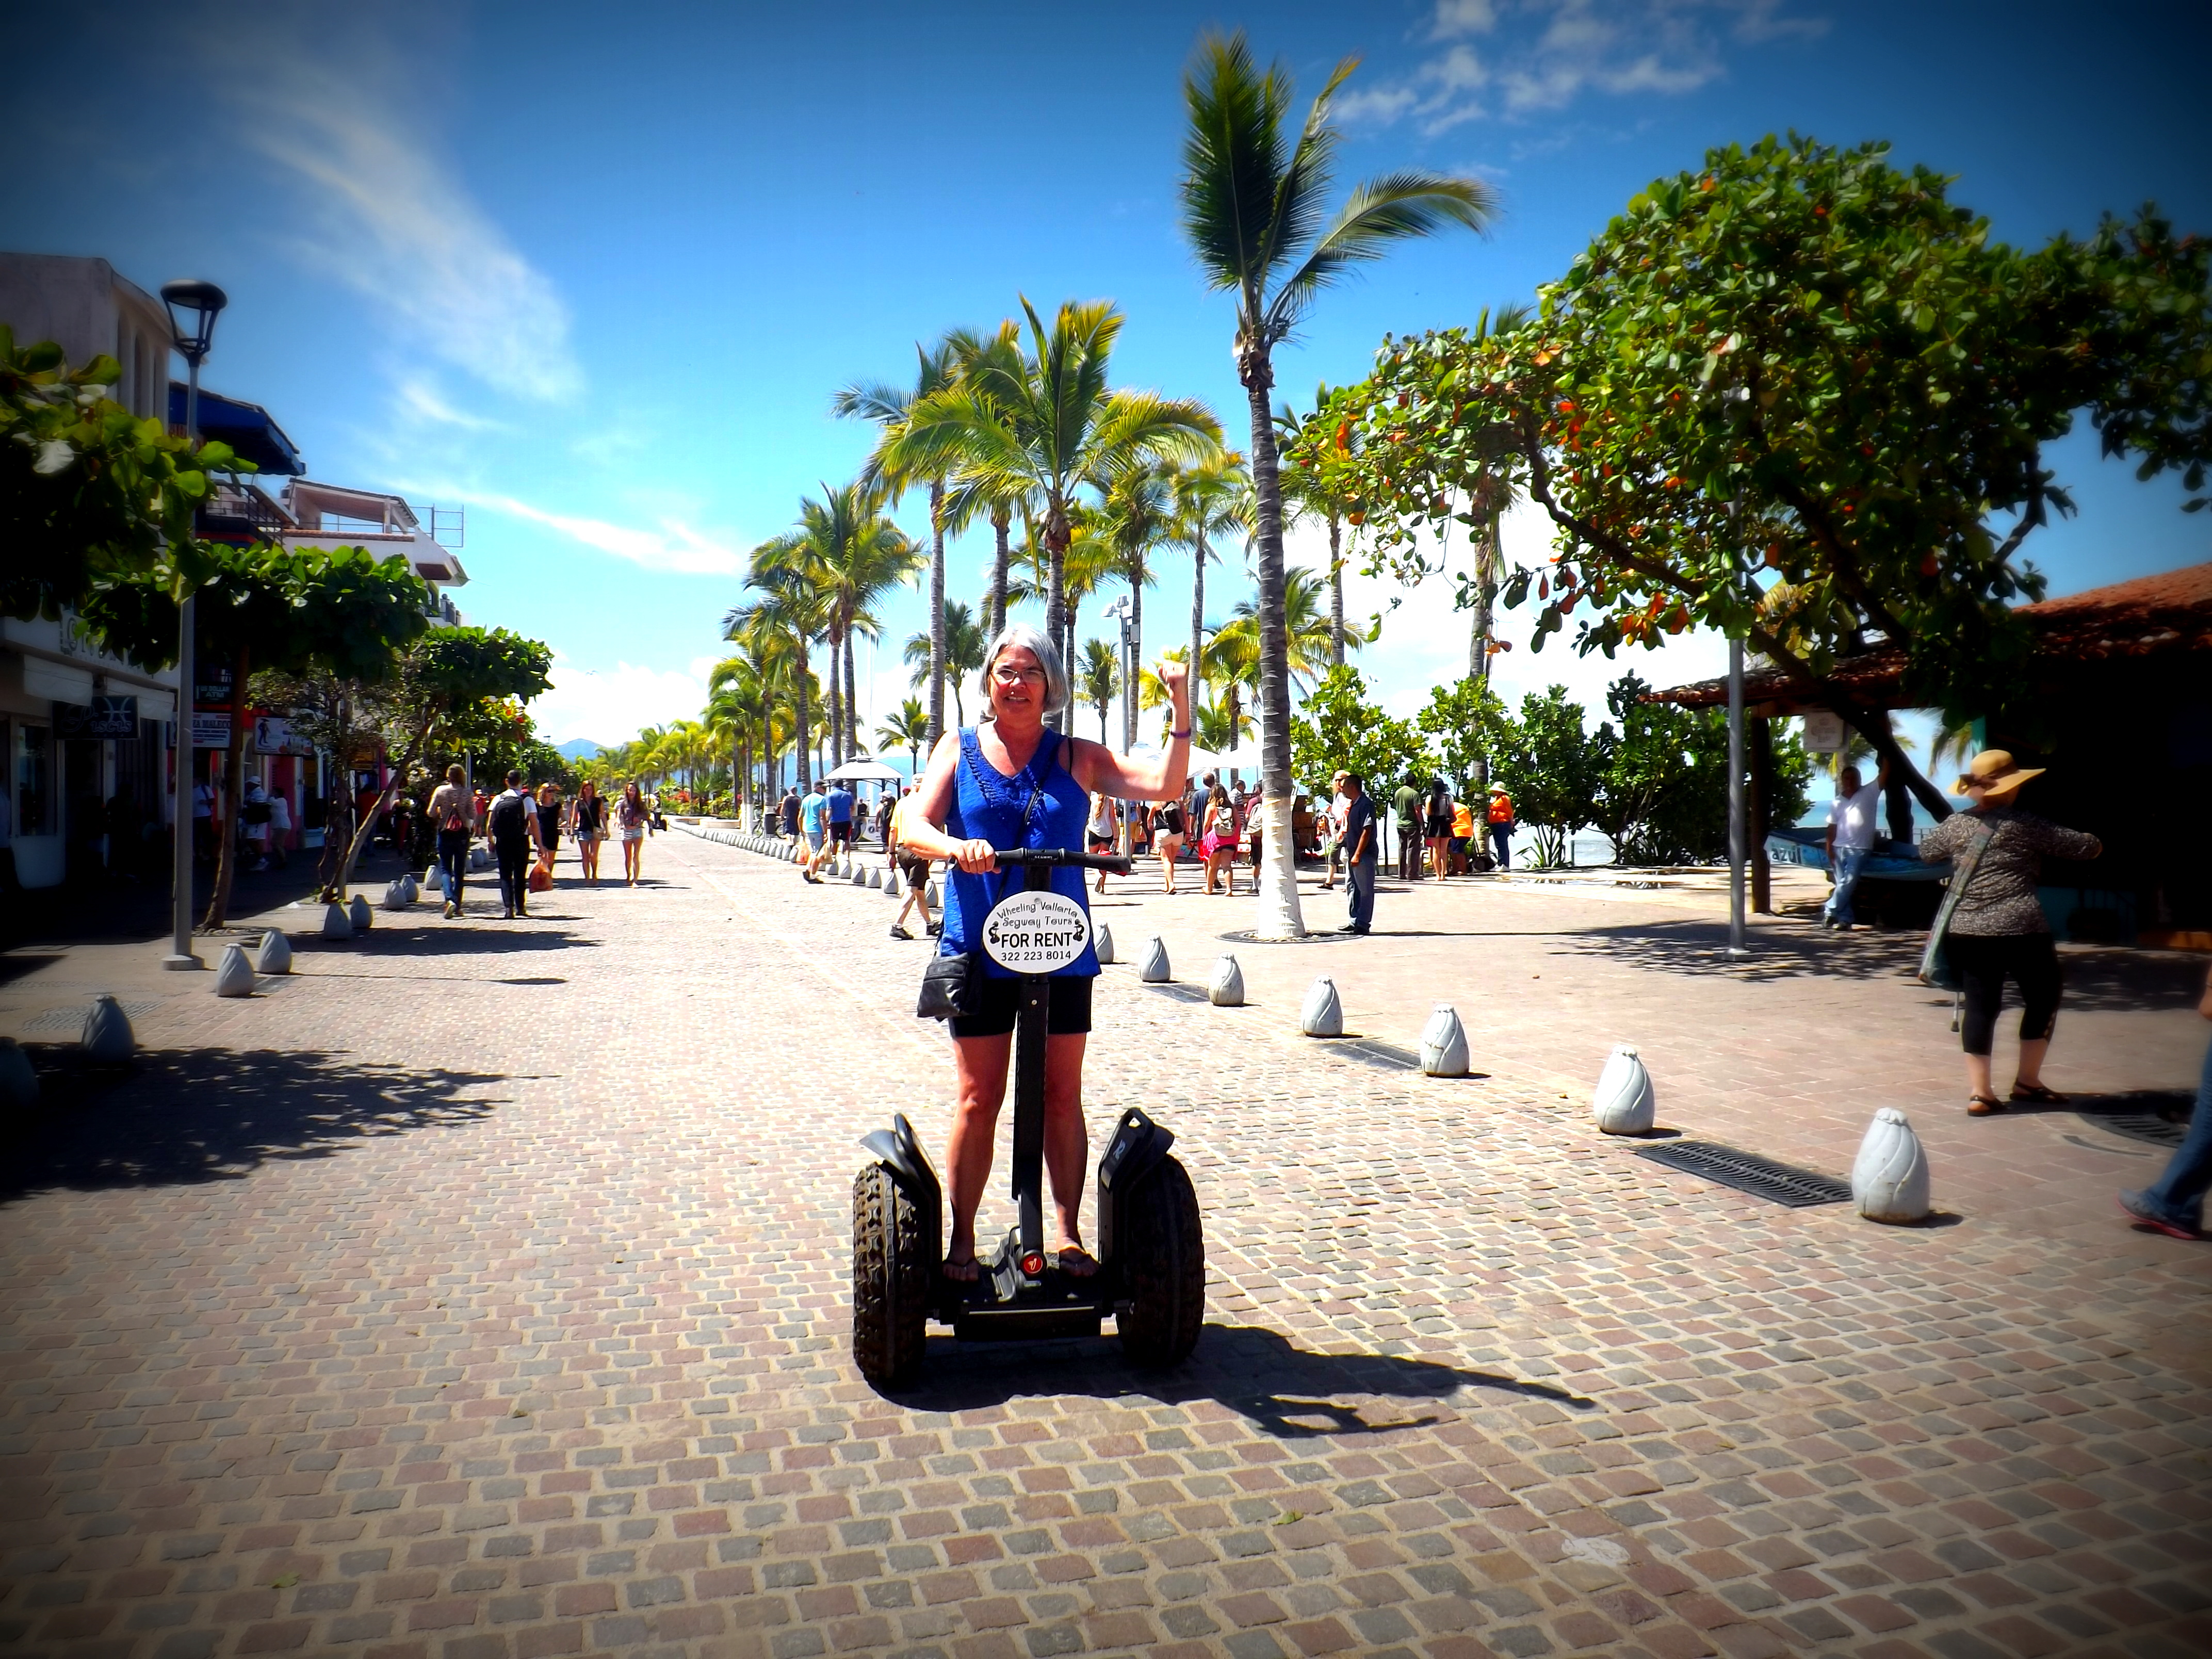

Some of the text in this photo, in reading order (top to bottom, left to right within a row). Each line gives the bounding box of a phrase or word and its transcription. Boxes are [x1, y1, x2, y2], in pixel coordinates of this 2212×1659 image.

[997, 901, 1078, 919] Wheeling Vallarta
[1002, 916, 1072, 929] Segway Tours
[1001, 932, 1072, 948] FOR RENT
[1001, 951, 1071, 961] 322 223 8014
